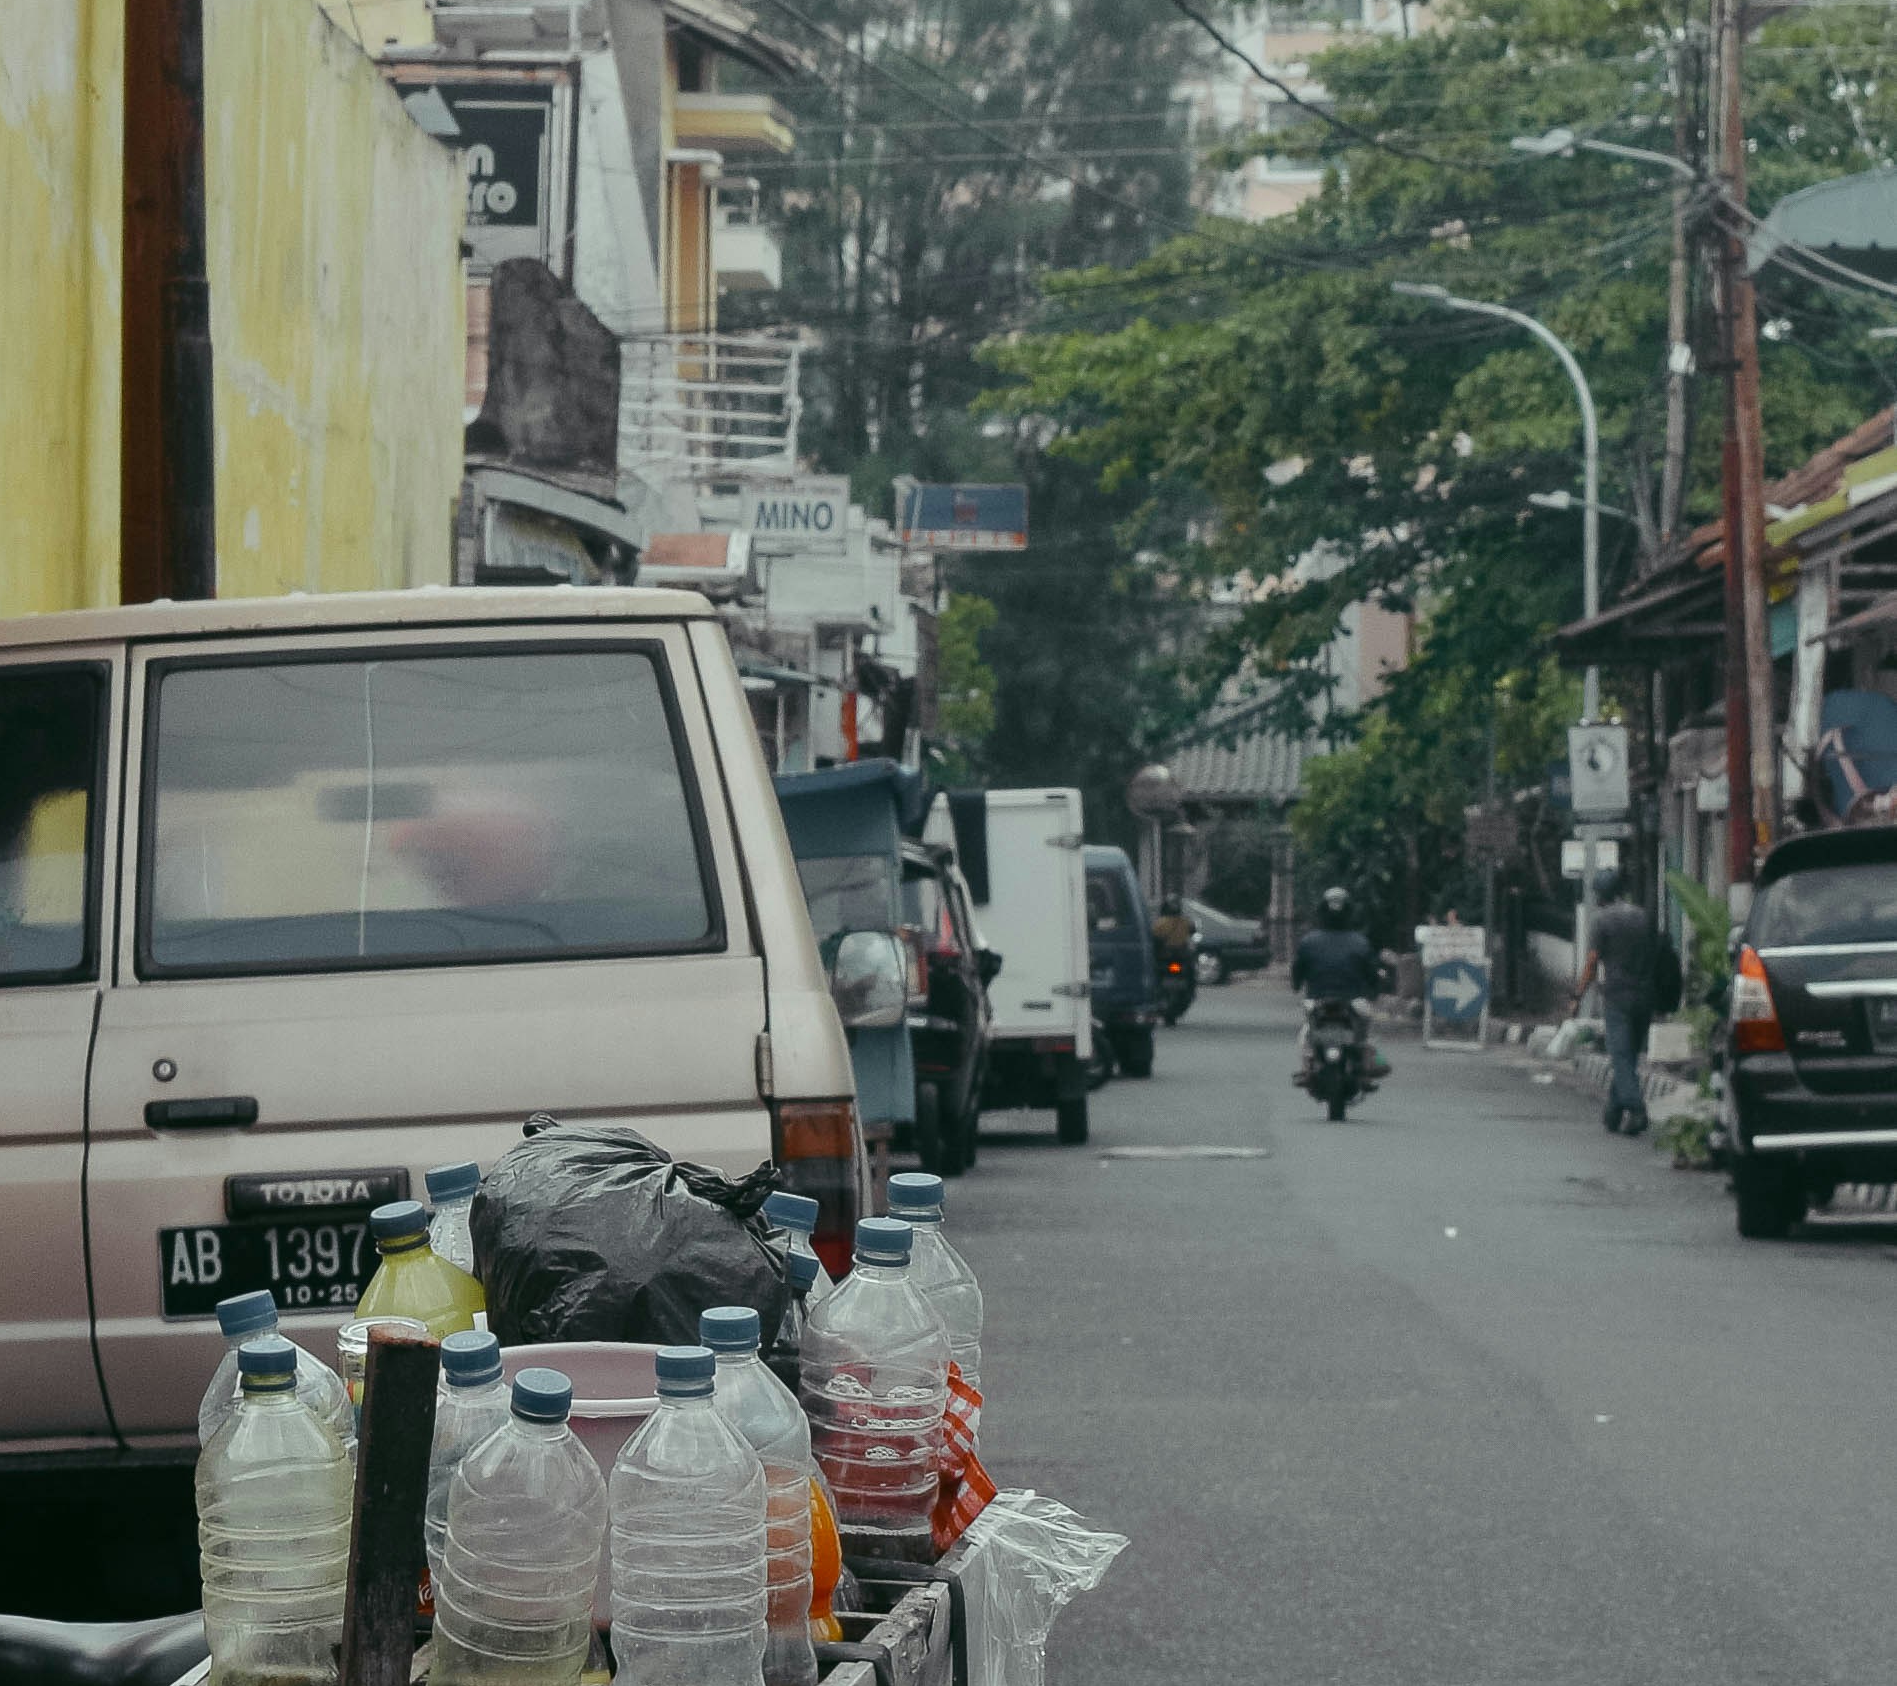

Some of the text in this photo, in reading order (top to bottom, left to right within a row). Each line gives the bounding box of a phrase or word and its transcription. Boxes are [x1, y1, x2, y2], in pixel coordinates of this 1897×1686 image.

[754, 500, 833, 531] MINO
[260, 1179, 370, 1205] TOYOTA
[170, 1224, 367, 1285] AB 1397
